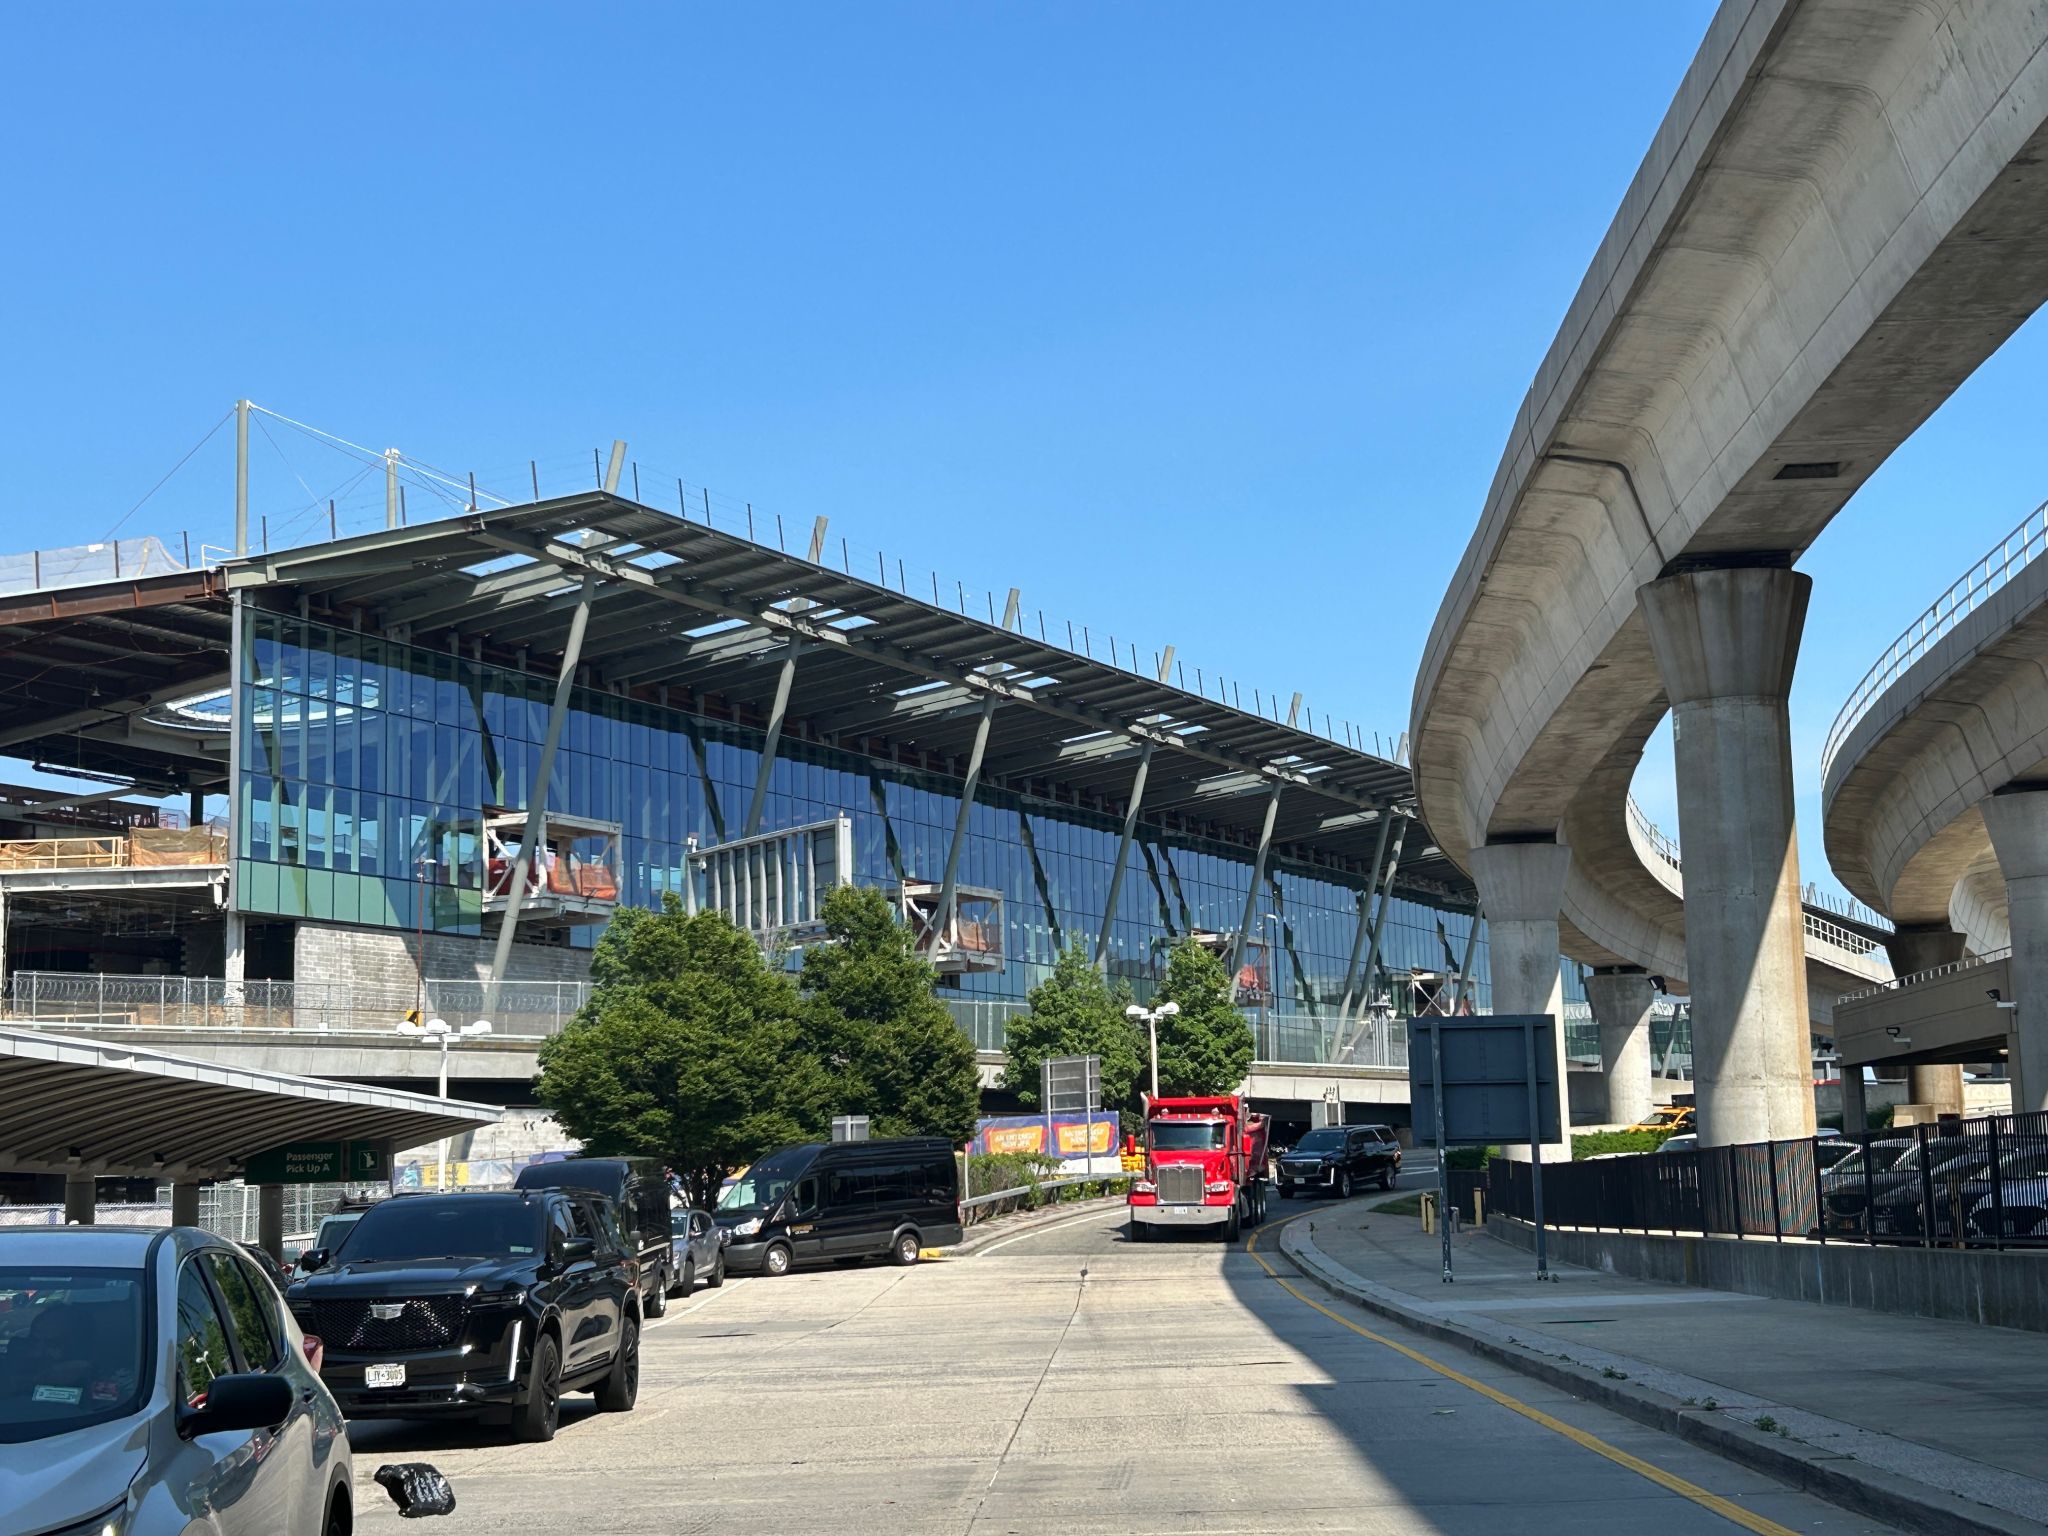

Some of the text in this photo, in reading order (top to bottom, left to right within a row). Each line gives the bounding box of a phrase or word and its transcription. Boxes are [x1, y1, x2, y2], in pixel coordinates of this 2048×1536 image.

[287, 1152, 333, 1162] Passenger
[286, 1163, 330, 1174] Pick Up A
